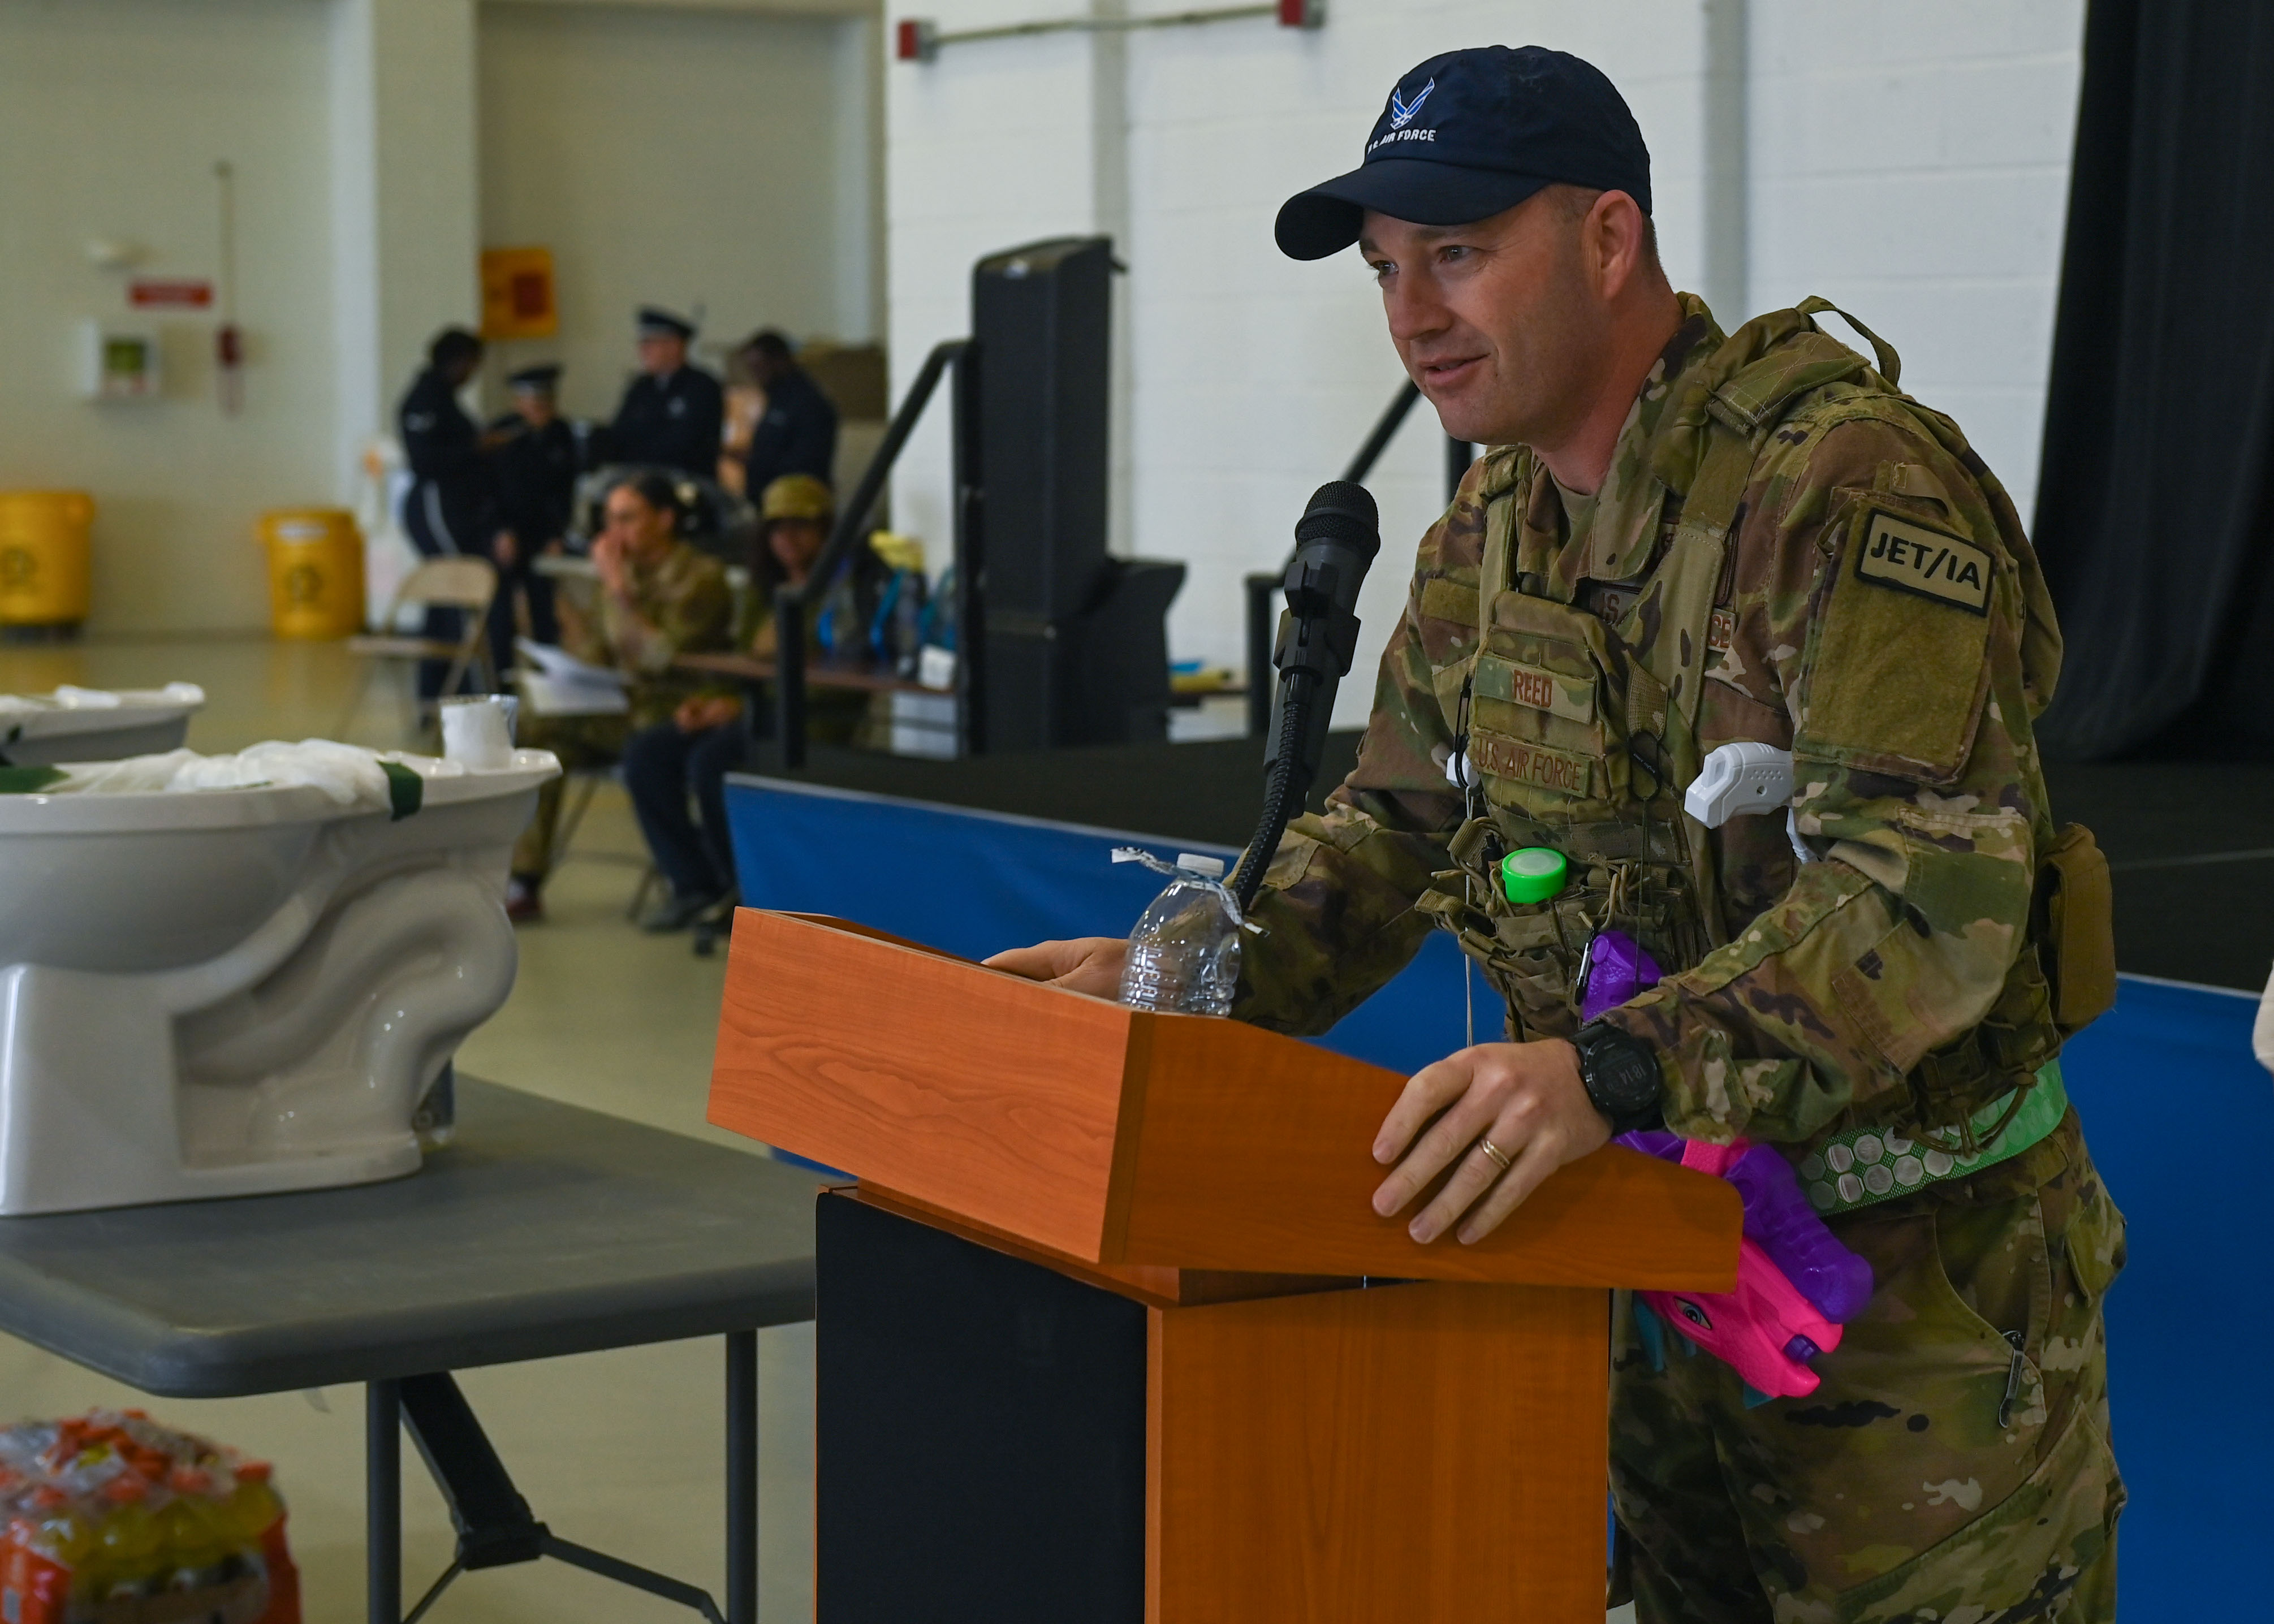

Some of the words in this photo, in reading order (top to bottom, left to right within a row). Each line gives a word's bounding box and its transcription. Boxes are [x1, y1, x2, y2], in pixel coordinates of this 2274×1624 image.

[1378, 132, 1396, 146] AIR
[1397, 128, 1436, 142] FORCE
[1870, 532, 1981, 591] JET/IA
[1513, 669, 1552, 708] REED
[1478, 737, 1501, 774] U.S.
[1505, 747, 1530, 780] AIR
[1531, 753, 1582, 792] FORCE
